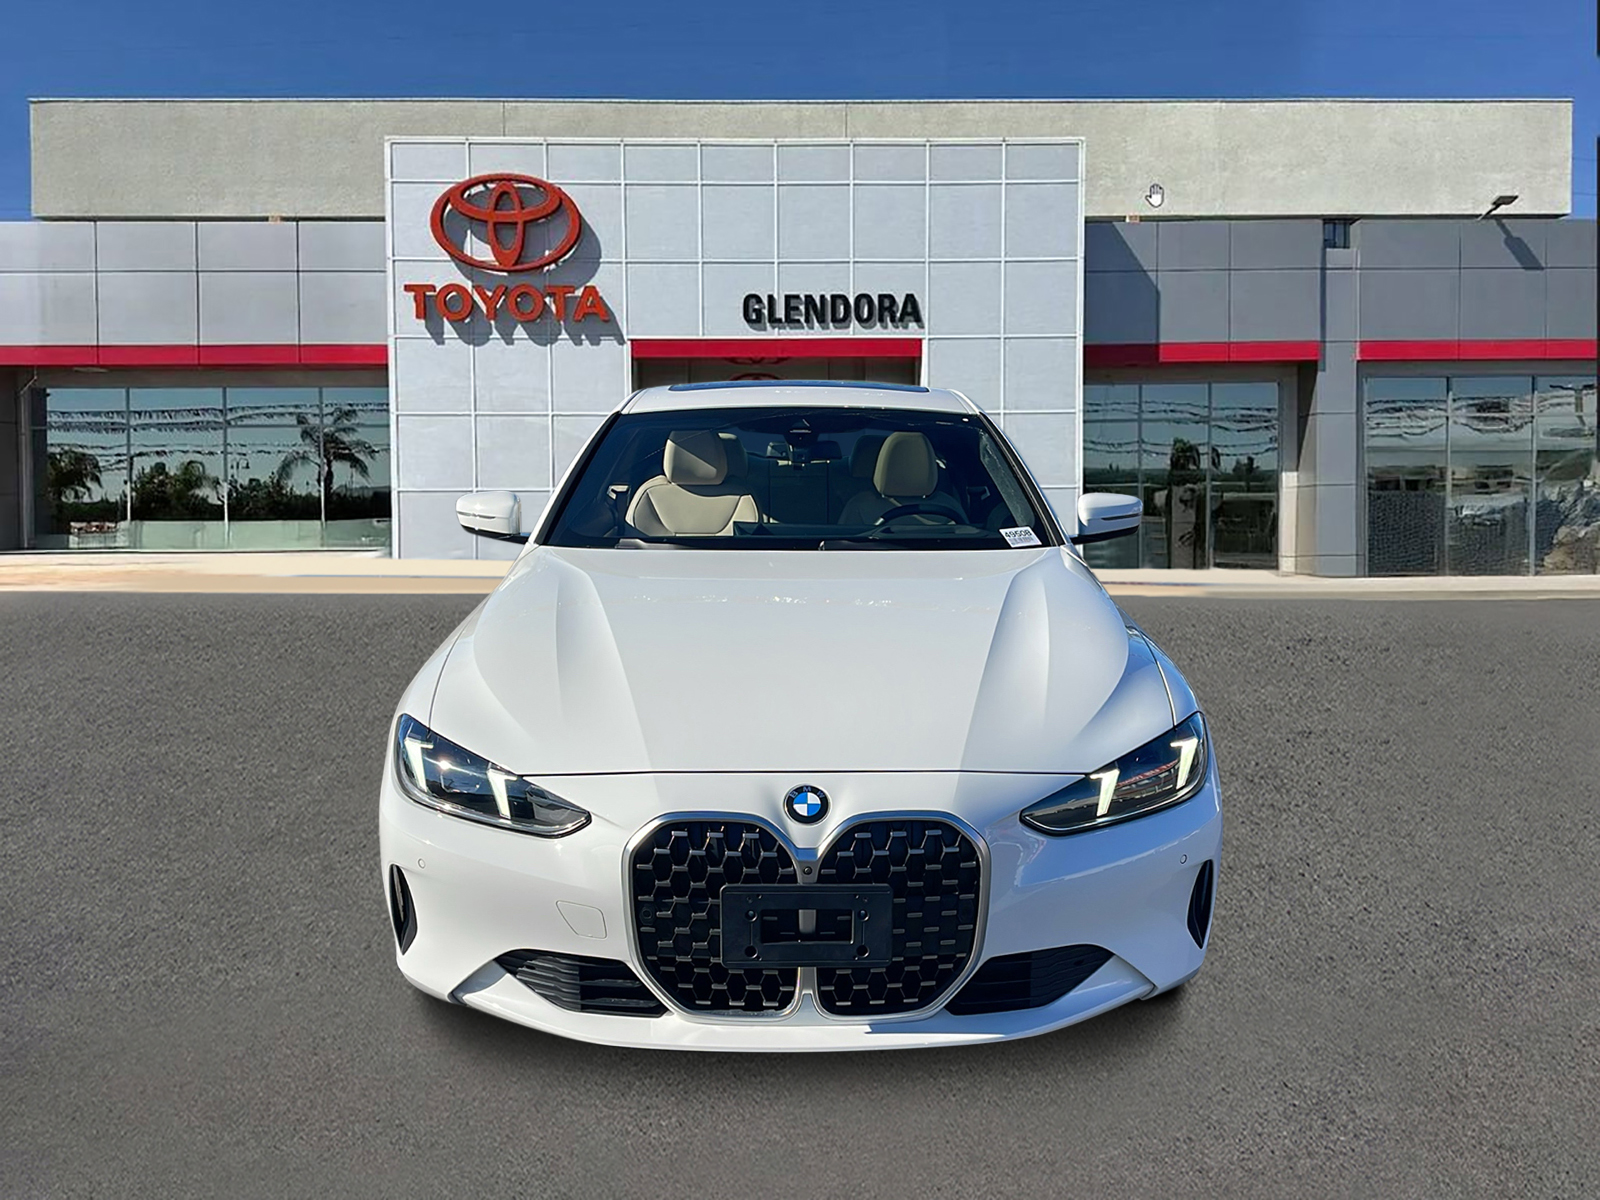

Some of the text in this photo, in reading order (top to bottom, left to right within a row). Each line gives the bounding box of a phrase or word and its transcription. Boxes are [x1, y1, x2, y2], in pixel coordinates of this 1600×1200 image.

[404, 283, 609, 322] TOYOTA
[743, 293, 923, 326] GLENDORA
[789, 786, 825, 798] BMW
